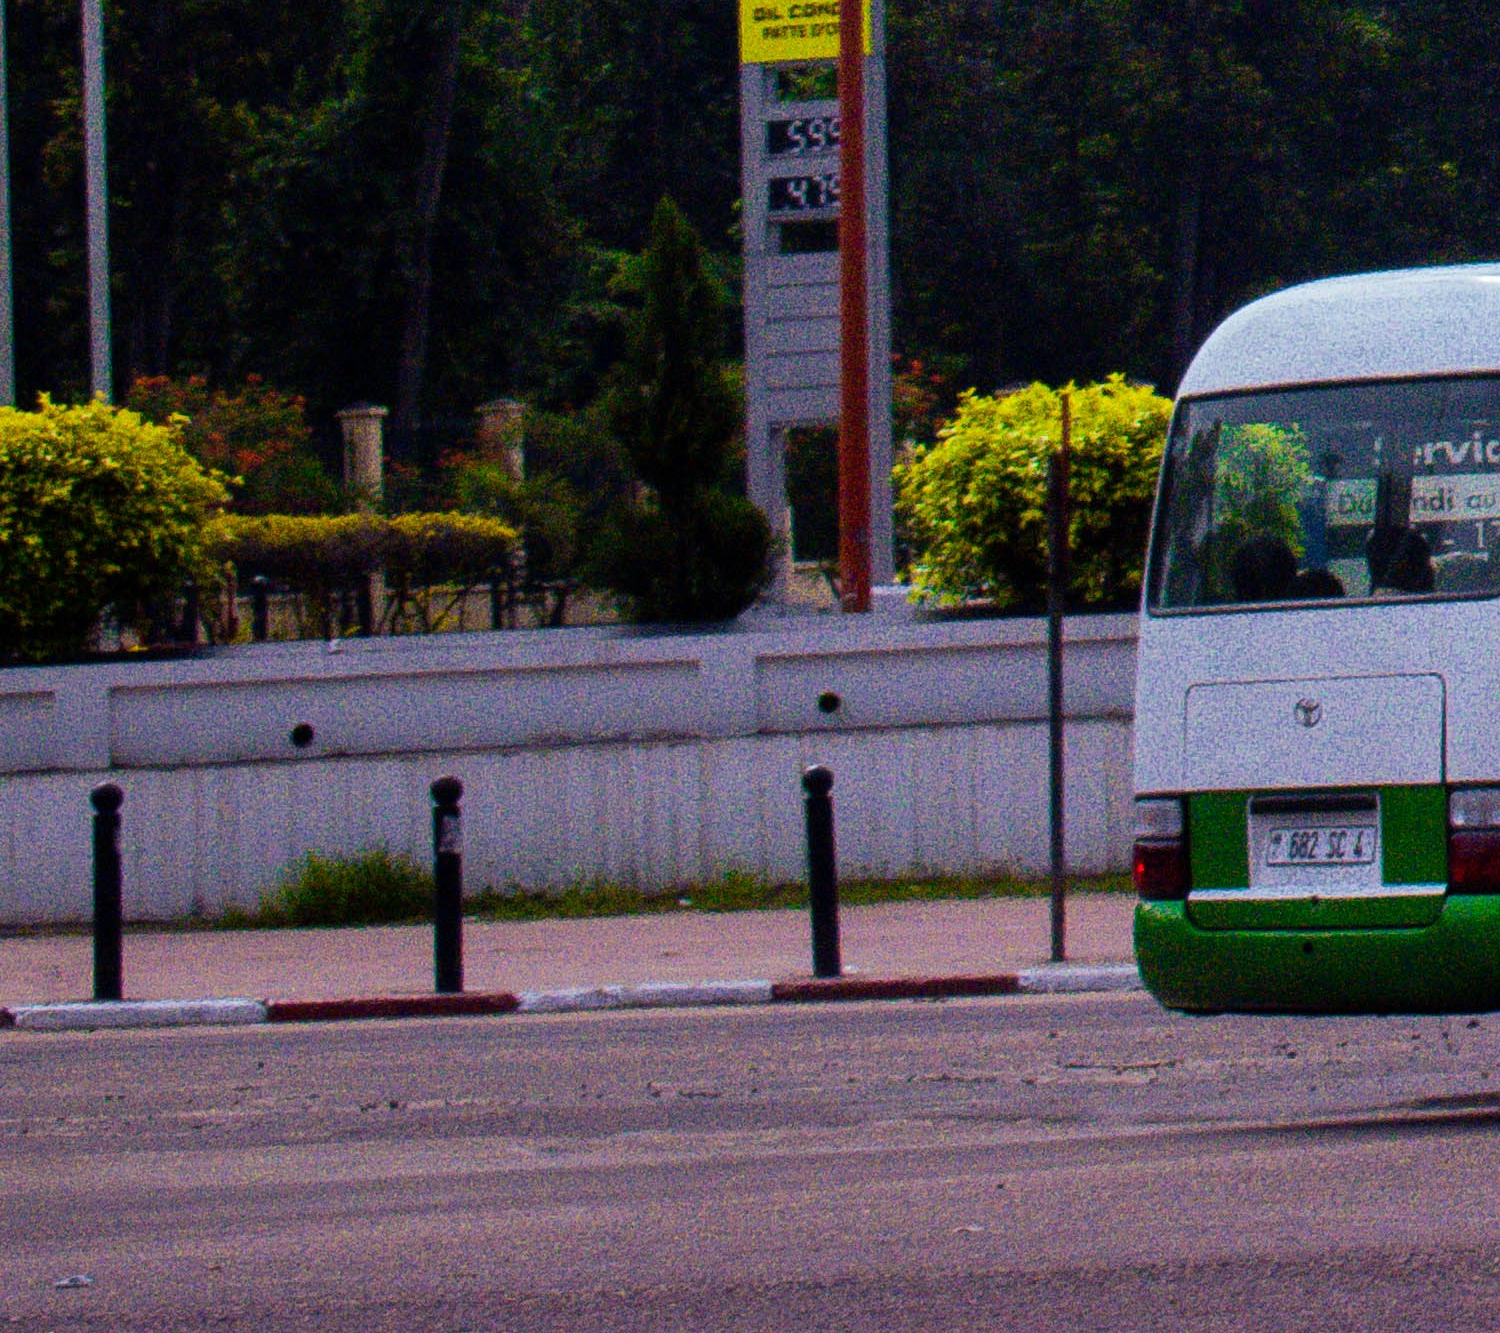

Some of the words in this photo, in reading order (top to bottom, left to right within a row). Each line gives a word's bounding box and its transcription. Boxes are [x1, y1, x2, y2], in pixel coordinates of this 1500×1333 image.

[753, 7, 783, 22] OIL
[789, 3, 841, 19] CONG
[811, 22, 841, 37] D'O
